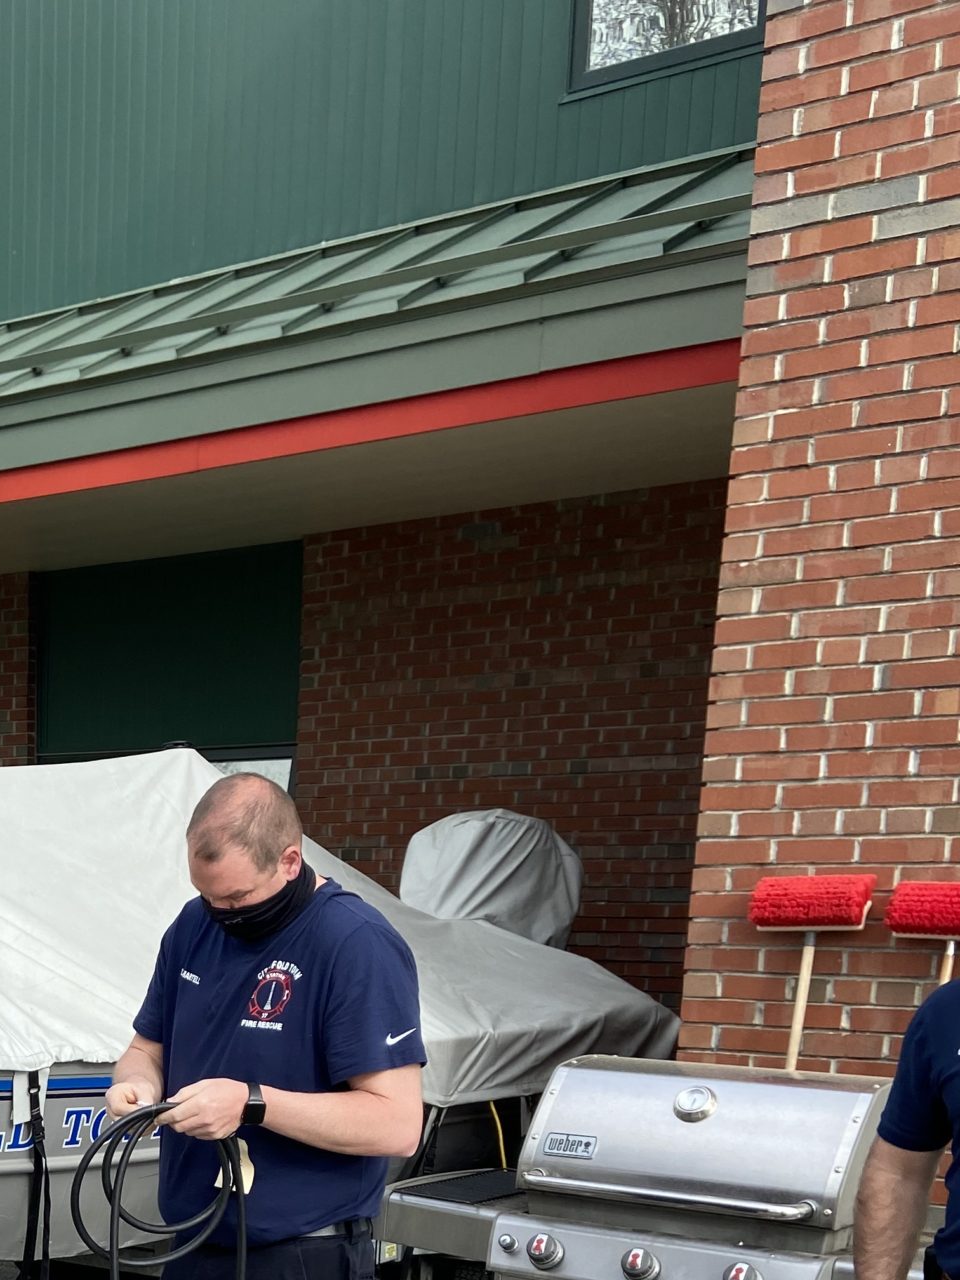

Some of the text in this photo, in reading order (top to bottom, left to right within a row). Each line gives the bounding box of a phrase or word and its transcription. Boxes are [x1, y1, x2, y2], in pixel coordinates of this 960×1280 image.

[277, 960, 290, 971] OLD
[241, 1019, 283, 1031] FIRE RESCUE
[548, 1134, 583, 1153] weber
